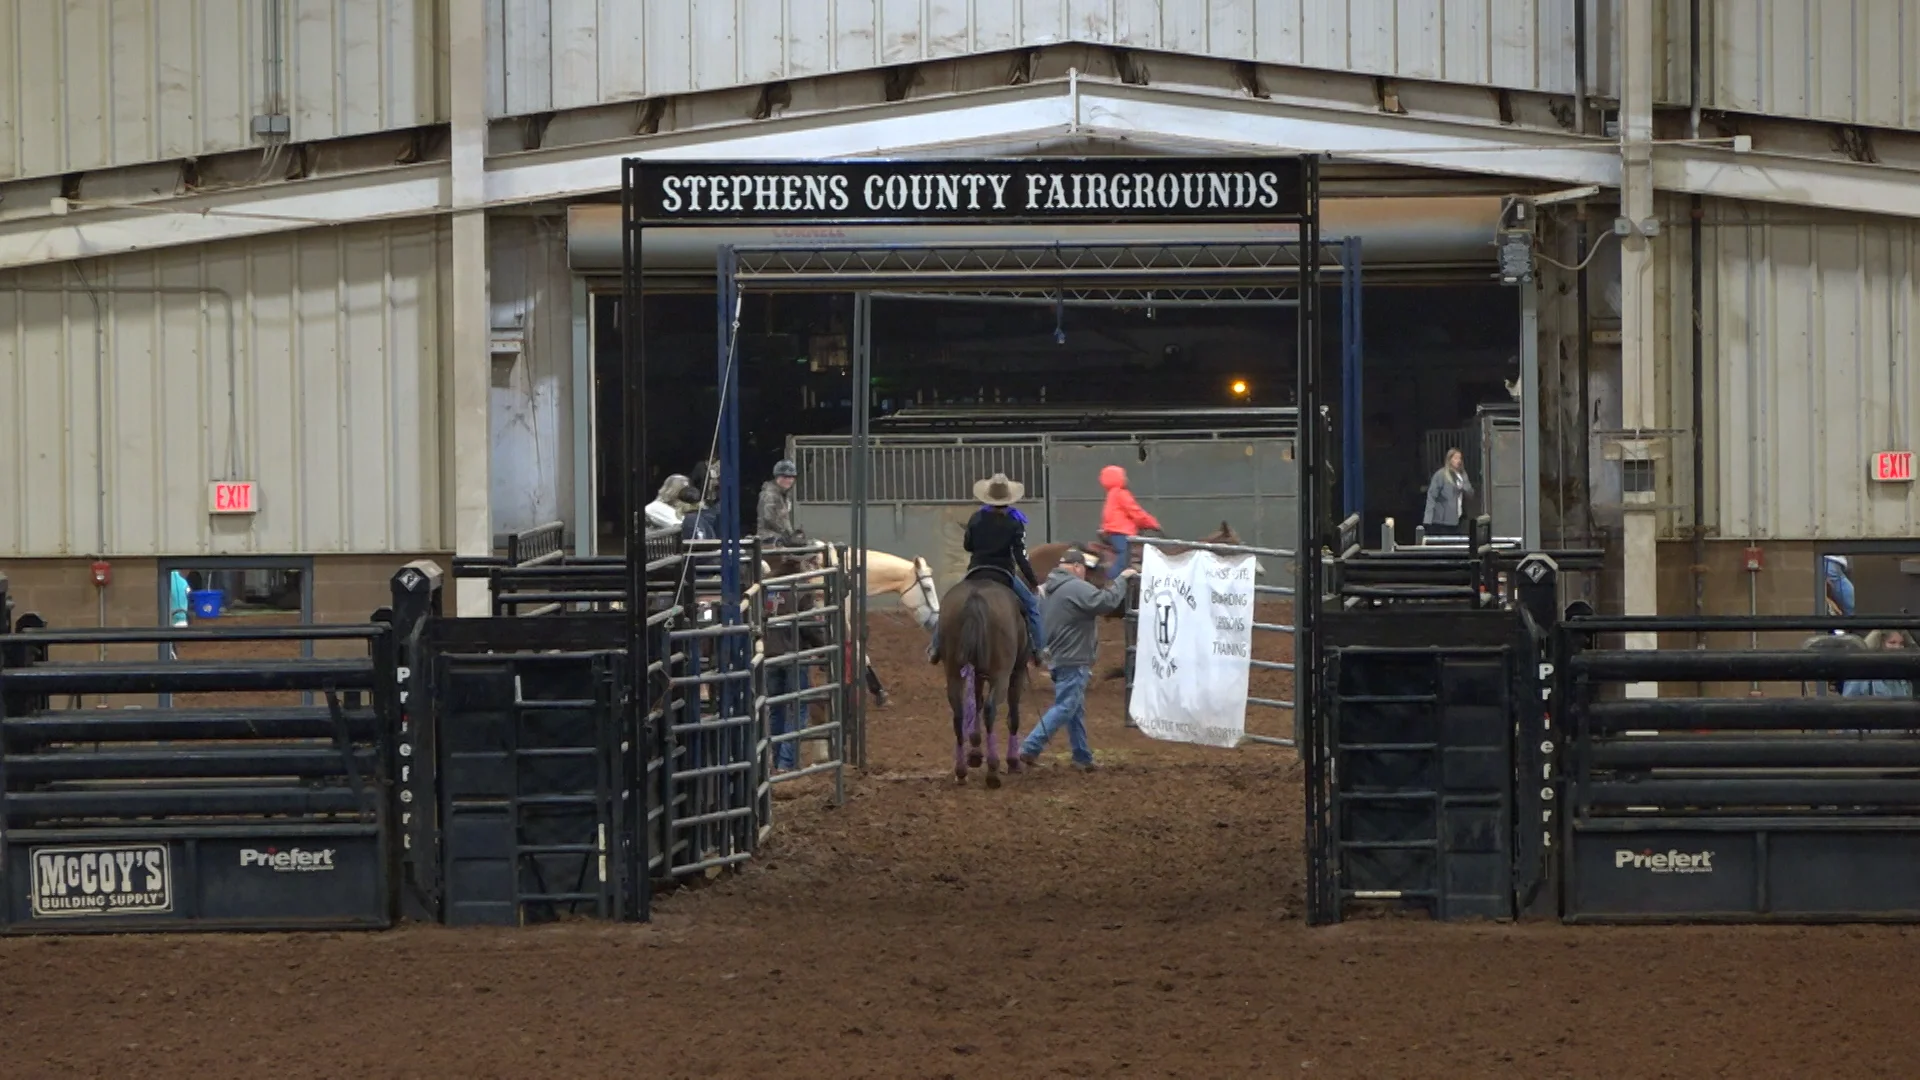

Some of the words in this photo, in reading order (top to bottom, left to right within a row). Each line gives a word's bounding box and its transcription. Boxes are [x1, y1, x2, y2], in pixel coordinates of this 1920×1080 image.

[662, 174, 849, 212] STEPHENS
[863, 174, 1010, 211] COUNTY
[1025, 172, 1278, 210] FAIRGROUNDS
[1879, 453, 1911, 478] EXIT
[216, 485, 251, 509] EXIT
[1212, 641, 1247, 658] TRAINING
[397, 666, 412, 849] Priefert
[1539, 663, 1555, 846] Priefert
[240, 847, 335, 866] Priefert
[1615, 849, 1713, 868] Priefert
[41, 895, 106, 908] BUILDING
